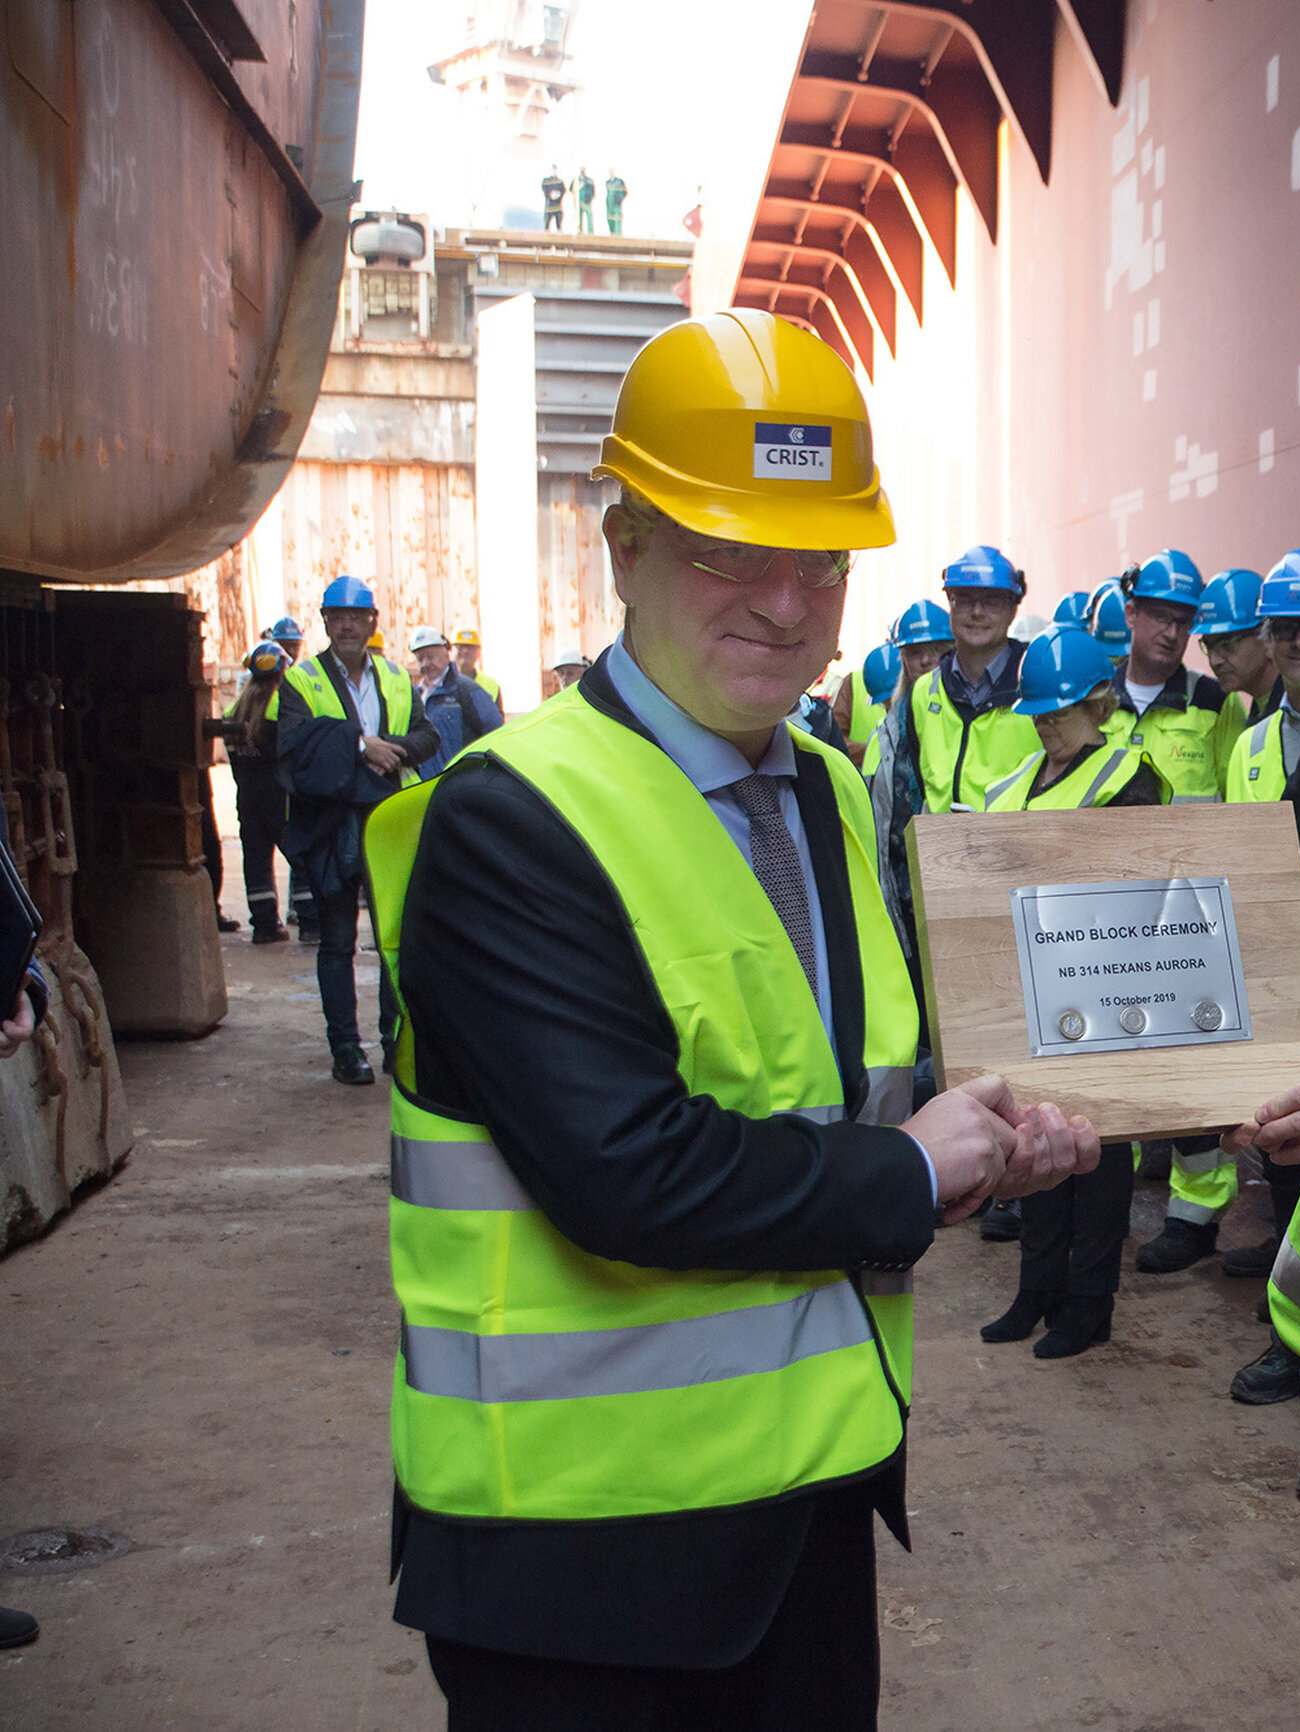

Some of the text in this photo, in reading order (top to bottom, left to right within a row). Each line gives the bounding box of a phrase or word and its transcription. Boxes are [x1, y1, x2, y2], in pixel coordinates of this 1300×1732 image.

[1034, 921, 1218, 944] GRAND BLOCK CEREMONY
[1058, 958, 1206, 978] NB 314 NEXANS AURORA
[1100, 992, 1176, 1007] 15 October 2019
